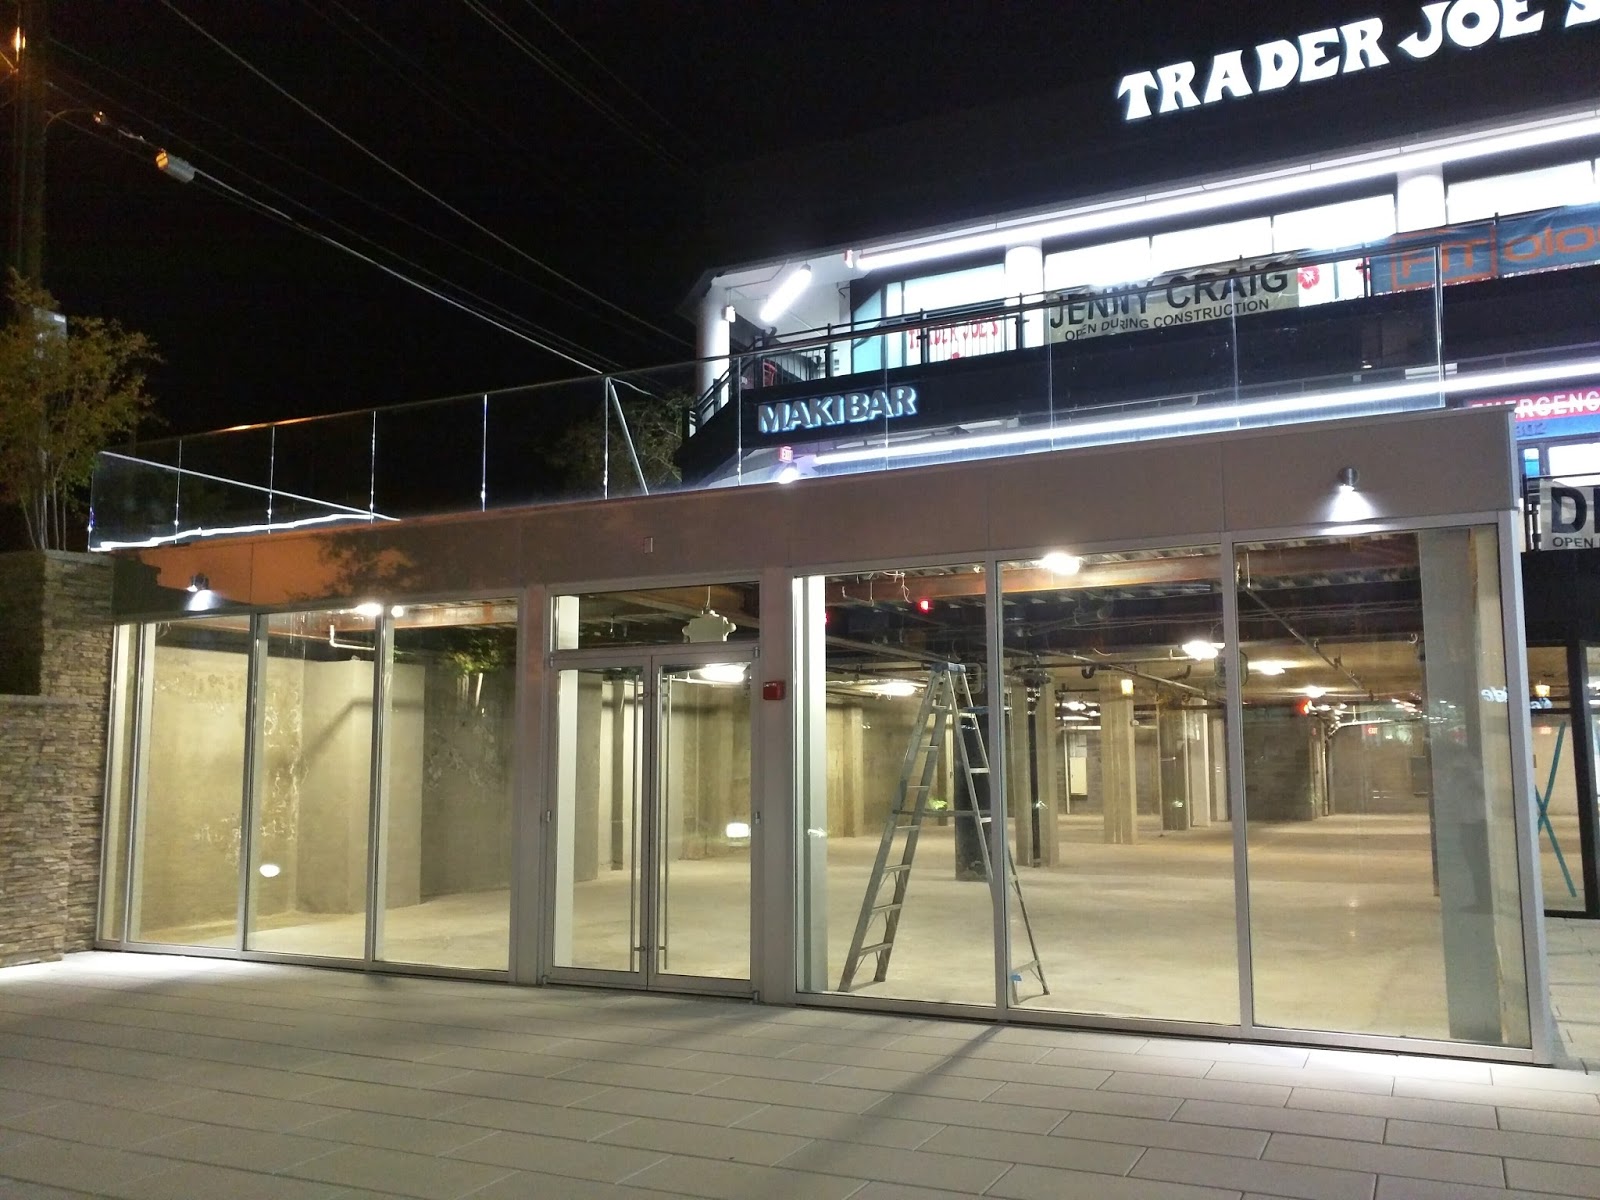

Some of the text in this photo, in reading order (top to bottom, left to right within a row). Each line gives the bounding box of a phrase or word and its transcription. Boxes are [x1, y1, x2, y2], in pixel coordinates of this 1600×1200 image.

[1117, 0, 1600, 121] TRADER JOE
[1050, 261, 1288, 328] JENNY CRAIG
[1065, 299, 1269, 341] OPEN DURING CONSTRUCTION
[1552, 536, 1594, 548] OPEN
